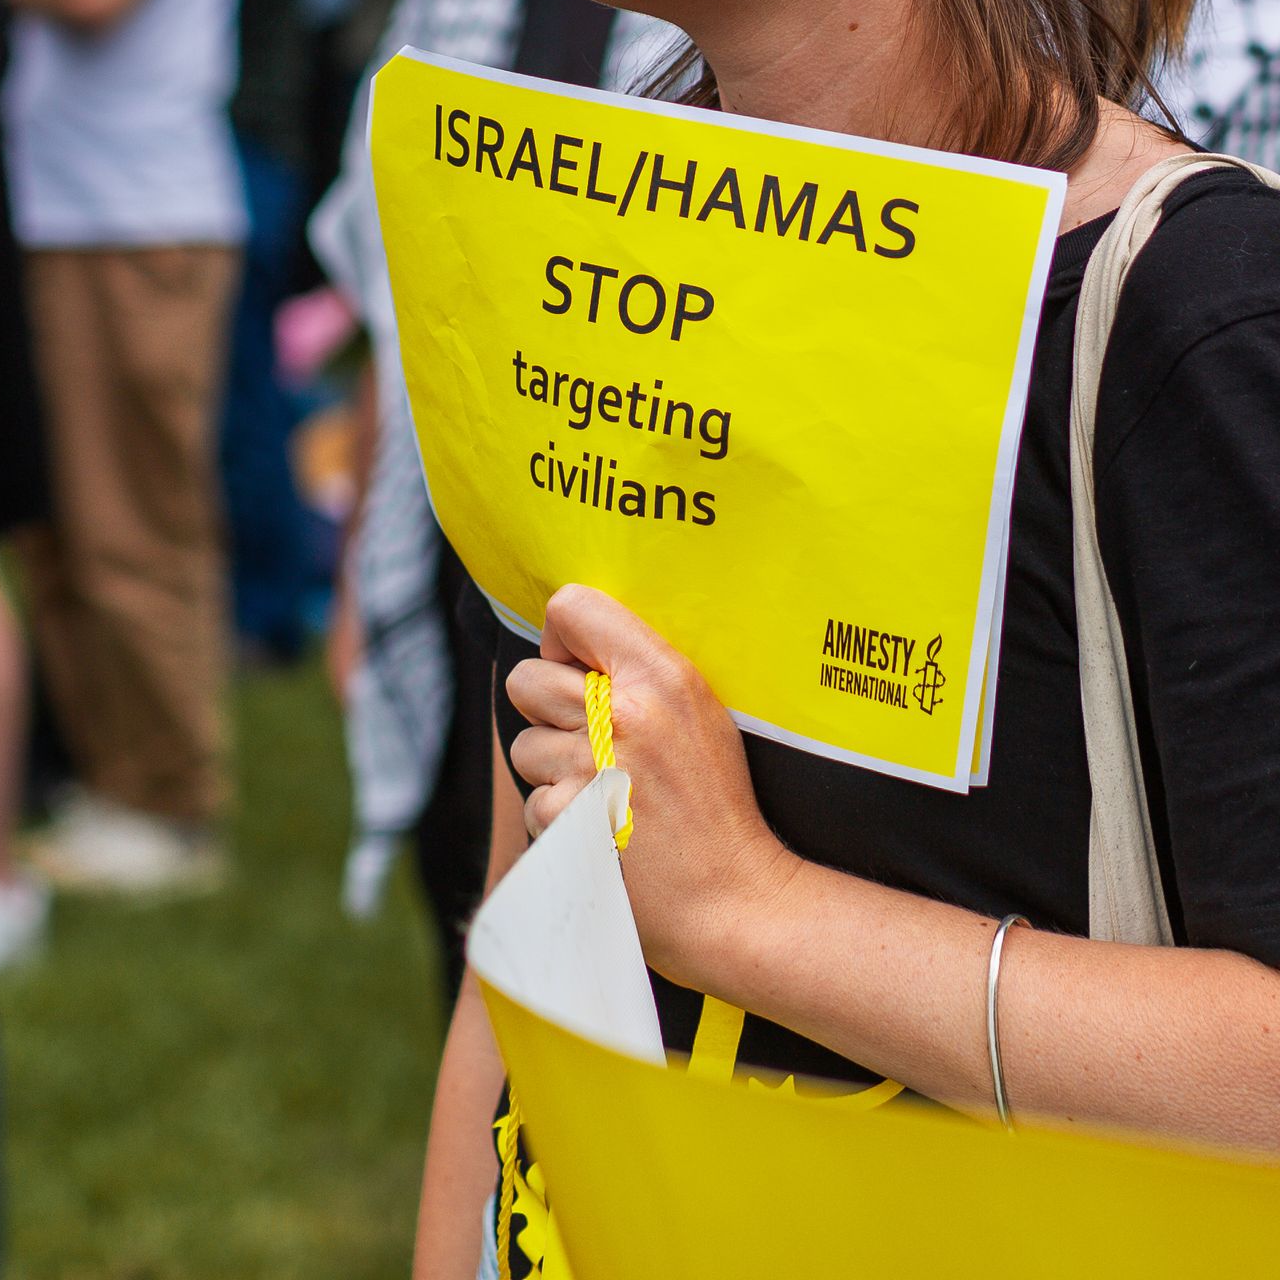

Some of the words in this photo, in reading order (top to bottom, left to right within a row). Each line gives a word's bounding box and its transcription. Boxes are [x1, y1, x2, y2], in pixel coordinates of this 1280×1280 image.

[434, 103, 920, 259] ISRAEL/HAMAS
[542, 255, 715, 342] STOP
[512, 350, 732, 461] targeting
[529, 440, 716, 526] civilians
[820, 663, 908, 710] INTERNATIONAL
[822, 618, 916, 677] AMNESTY
